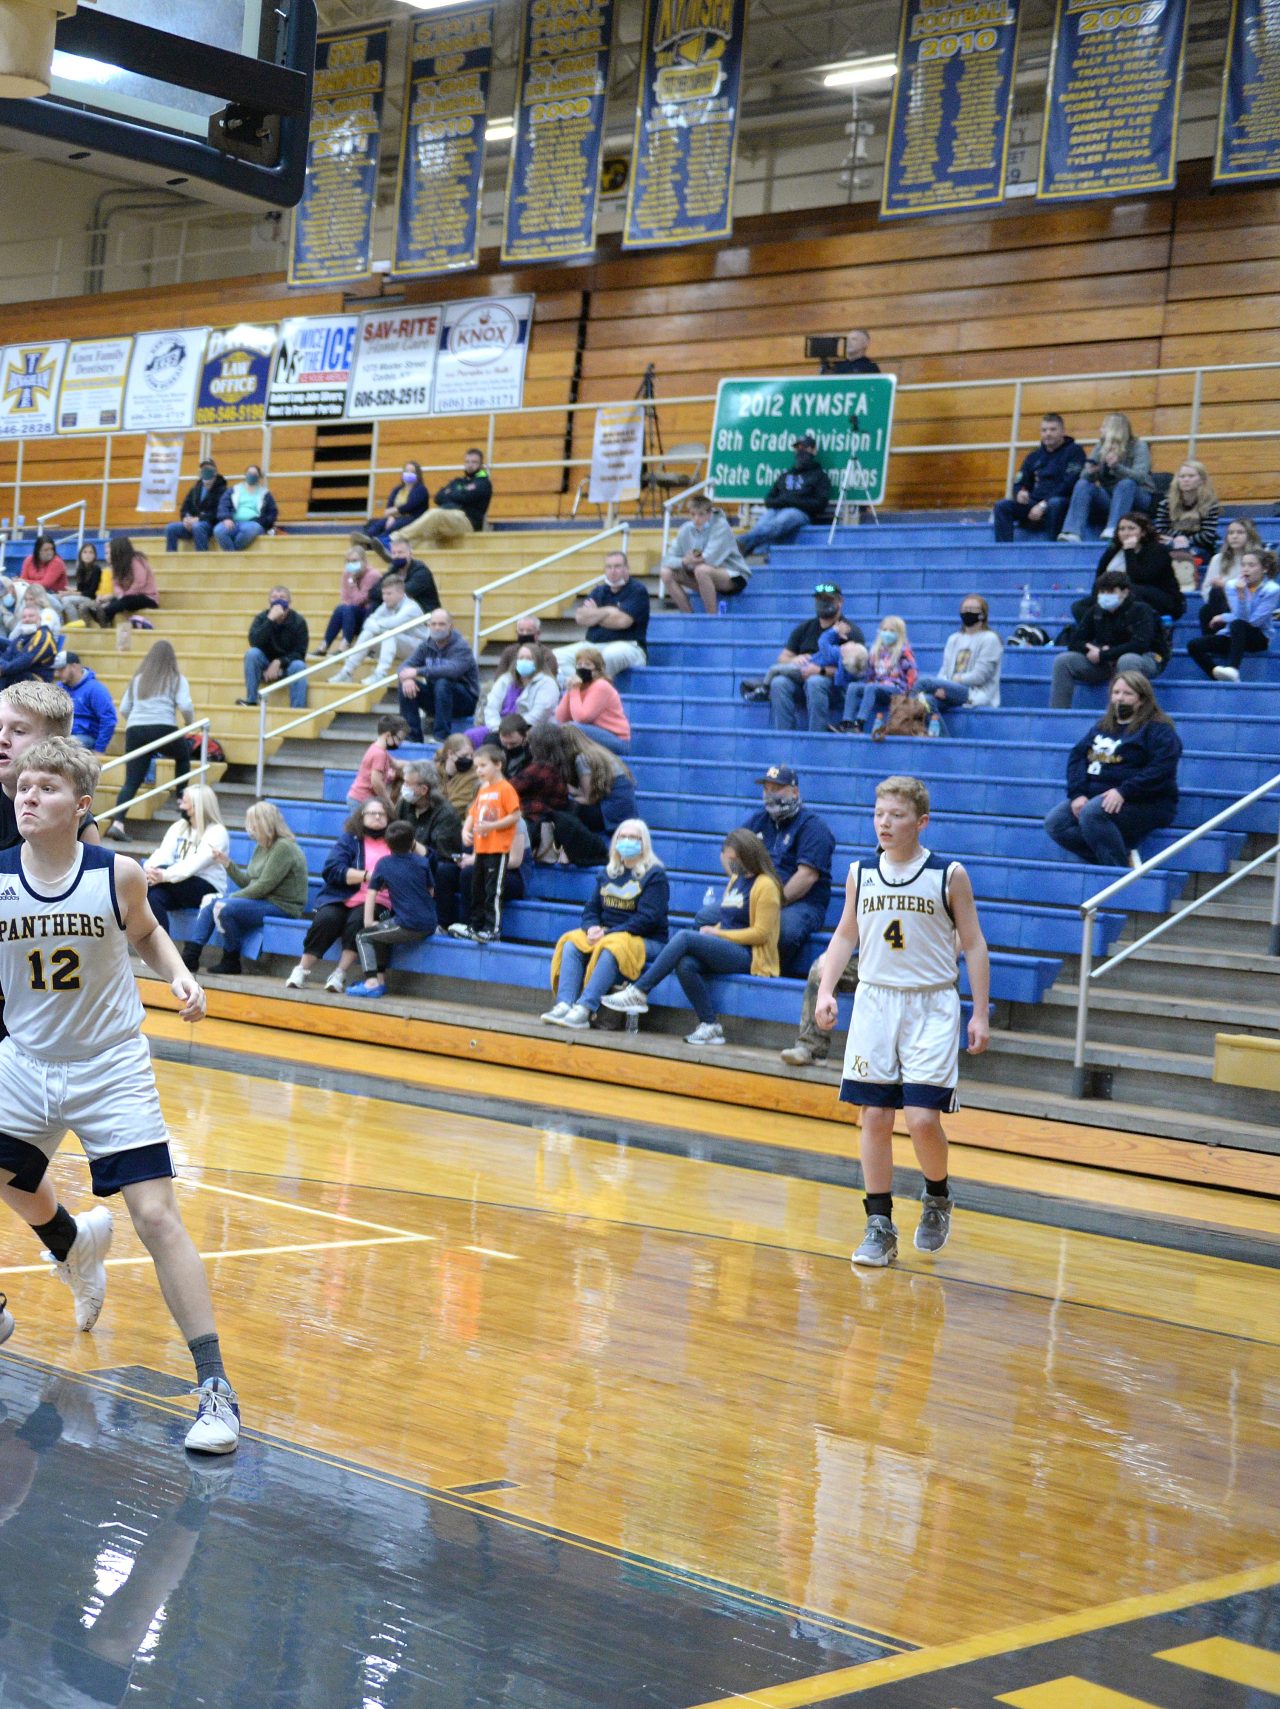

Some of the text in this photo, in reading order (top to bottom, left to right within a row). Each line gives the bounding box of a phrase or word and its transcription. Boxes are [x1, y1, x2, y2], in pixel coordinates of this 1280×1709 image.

[912, 1, 1014, 36] FOOTBALL
[1078, 1, 1166, 35] 2007
[532, 29, 601, 55] FOUR
[918, 28, 998, 60] 2010
[363, 317, 437, 342] SAV-RITE
[457, 326, 506, 345] KNOX
[96, 349, 123, 361] Family
[321, 327, 357, 370] ICE
[76, 364, 115, 375] Dentistry
[222, 361, 251, 375] LAW
[210, 376, 257, 394] OFFICE
[355, 387, 425, 408] 606-528-2515
[739, 392, 868, 417] 2012 KYMSFA
[717, 429, 743, 451] 8th
[750, 429, 797, 451] Grade
[716, 463, 750, 486] State
[862, 895, 935, 915] PANTHERS
[883, 919, 907, 951] 4
[27, 947, 81, 991] 12
[852, 1055, 869, 1078] KC
